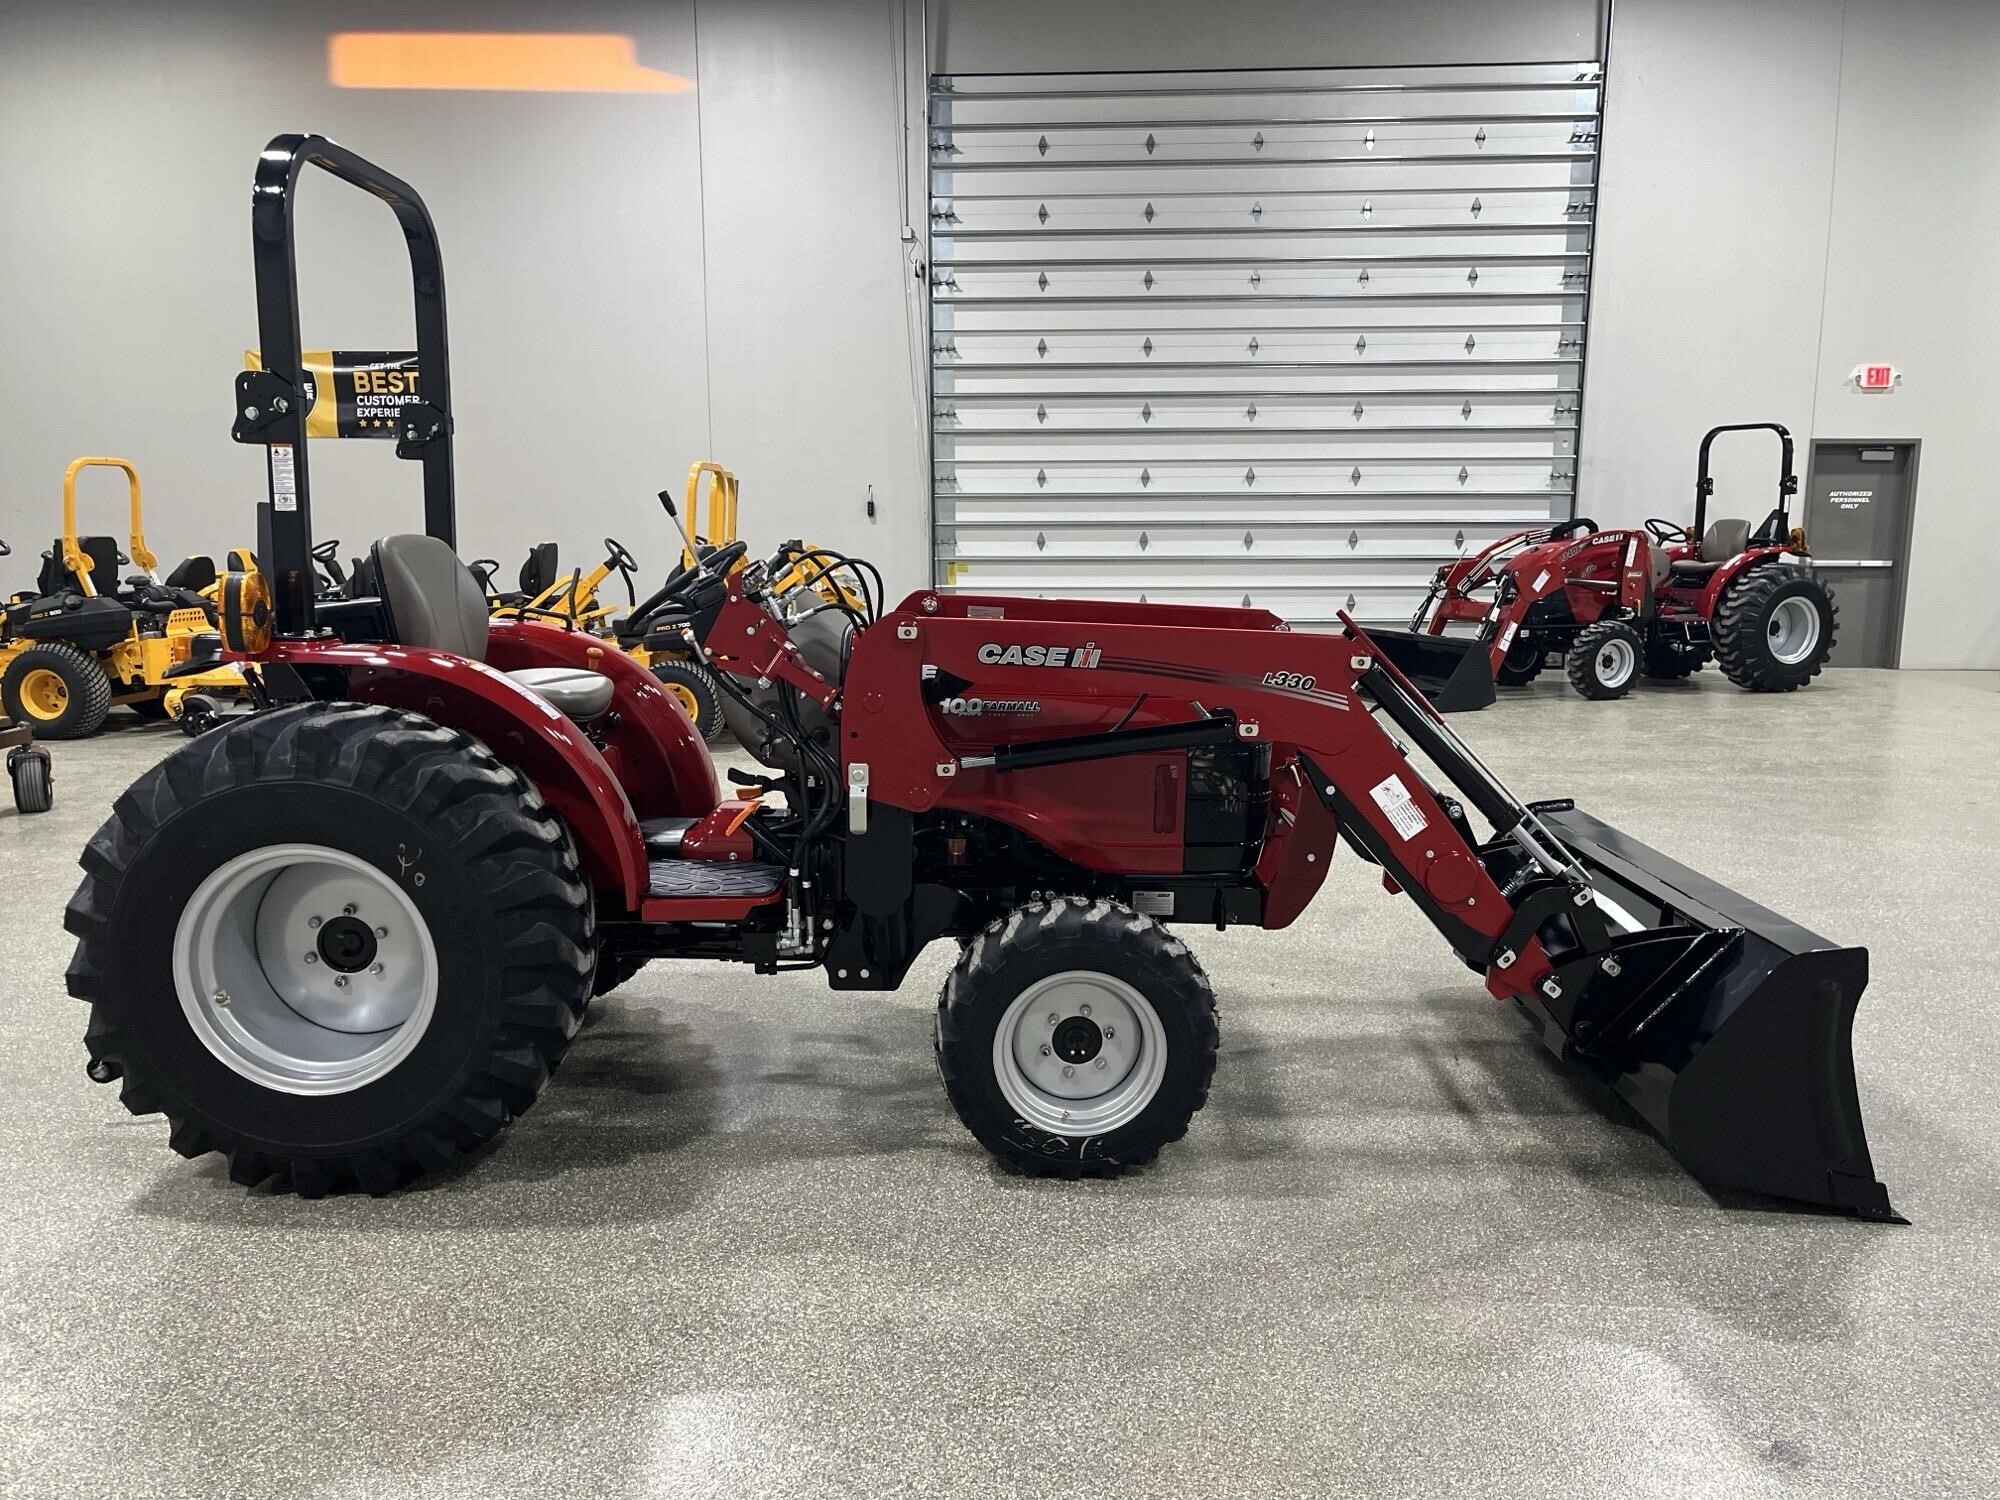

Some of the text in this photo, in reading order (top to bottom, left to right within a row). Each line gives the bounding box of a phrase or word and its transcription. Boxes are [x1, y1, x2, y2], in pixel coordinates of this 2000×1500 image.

[353, 371, 420, 394] BEST
[1867, 367, 1891, 386] EXIT
[356, 407, 401, 418] EXPERIE
[1592, 535, 1615, 545] CASE
[977, 643, 1070, 667] CASE
[1262, 670, 1317, 692] L330
[939, 698, 1040, 714] 100 FARMALL
